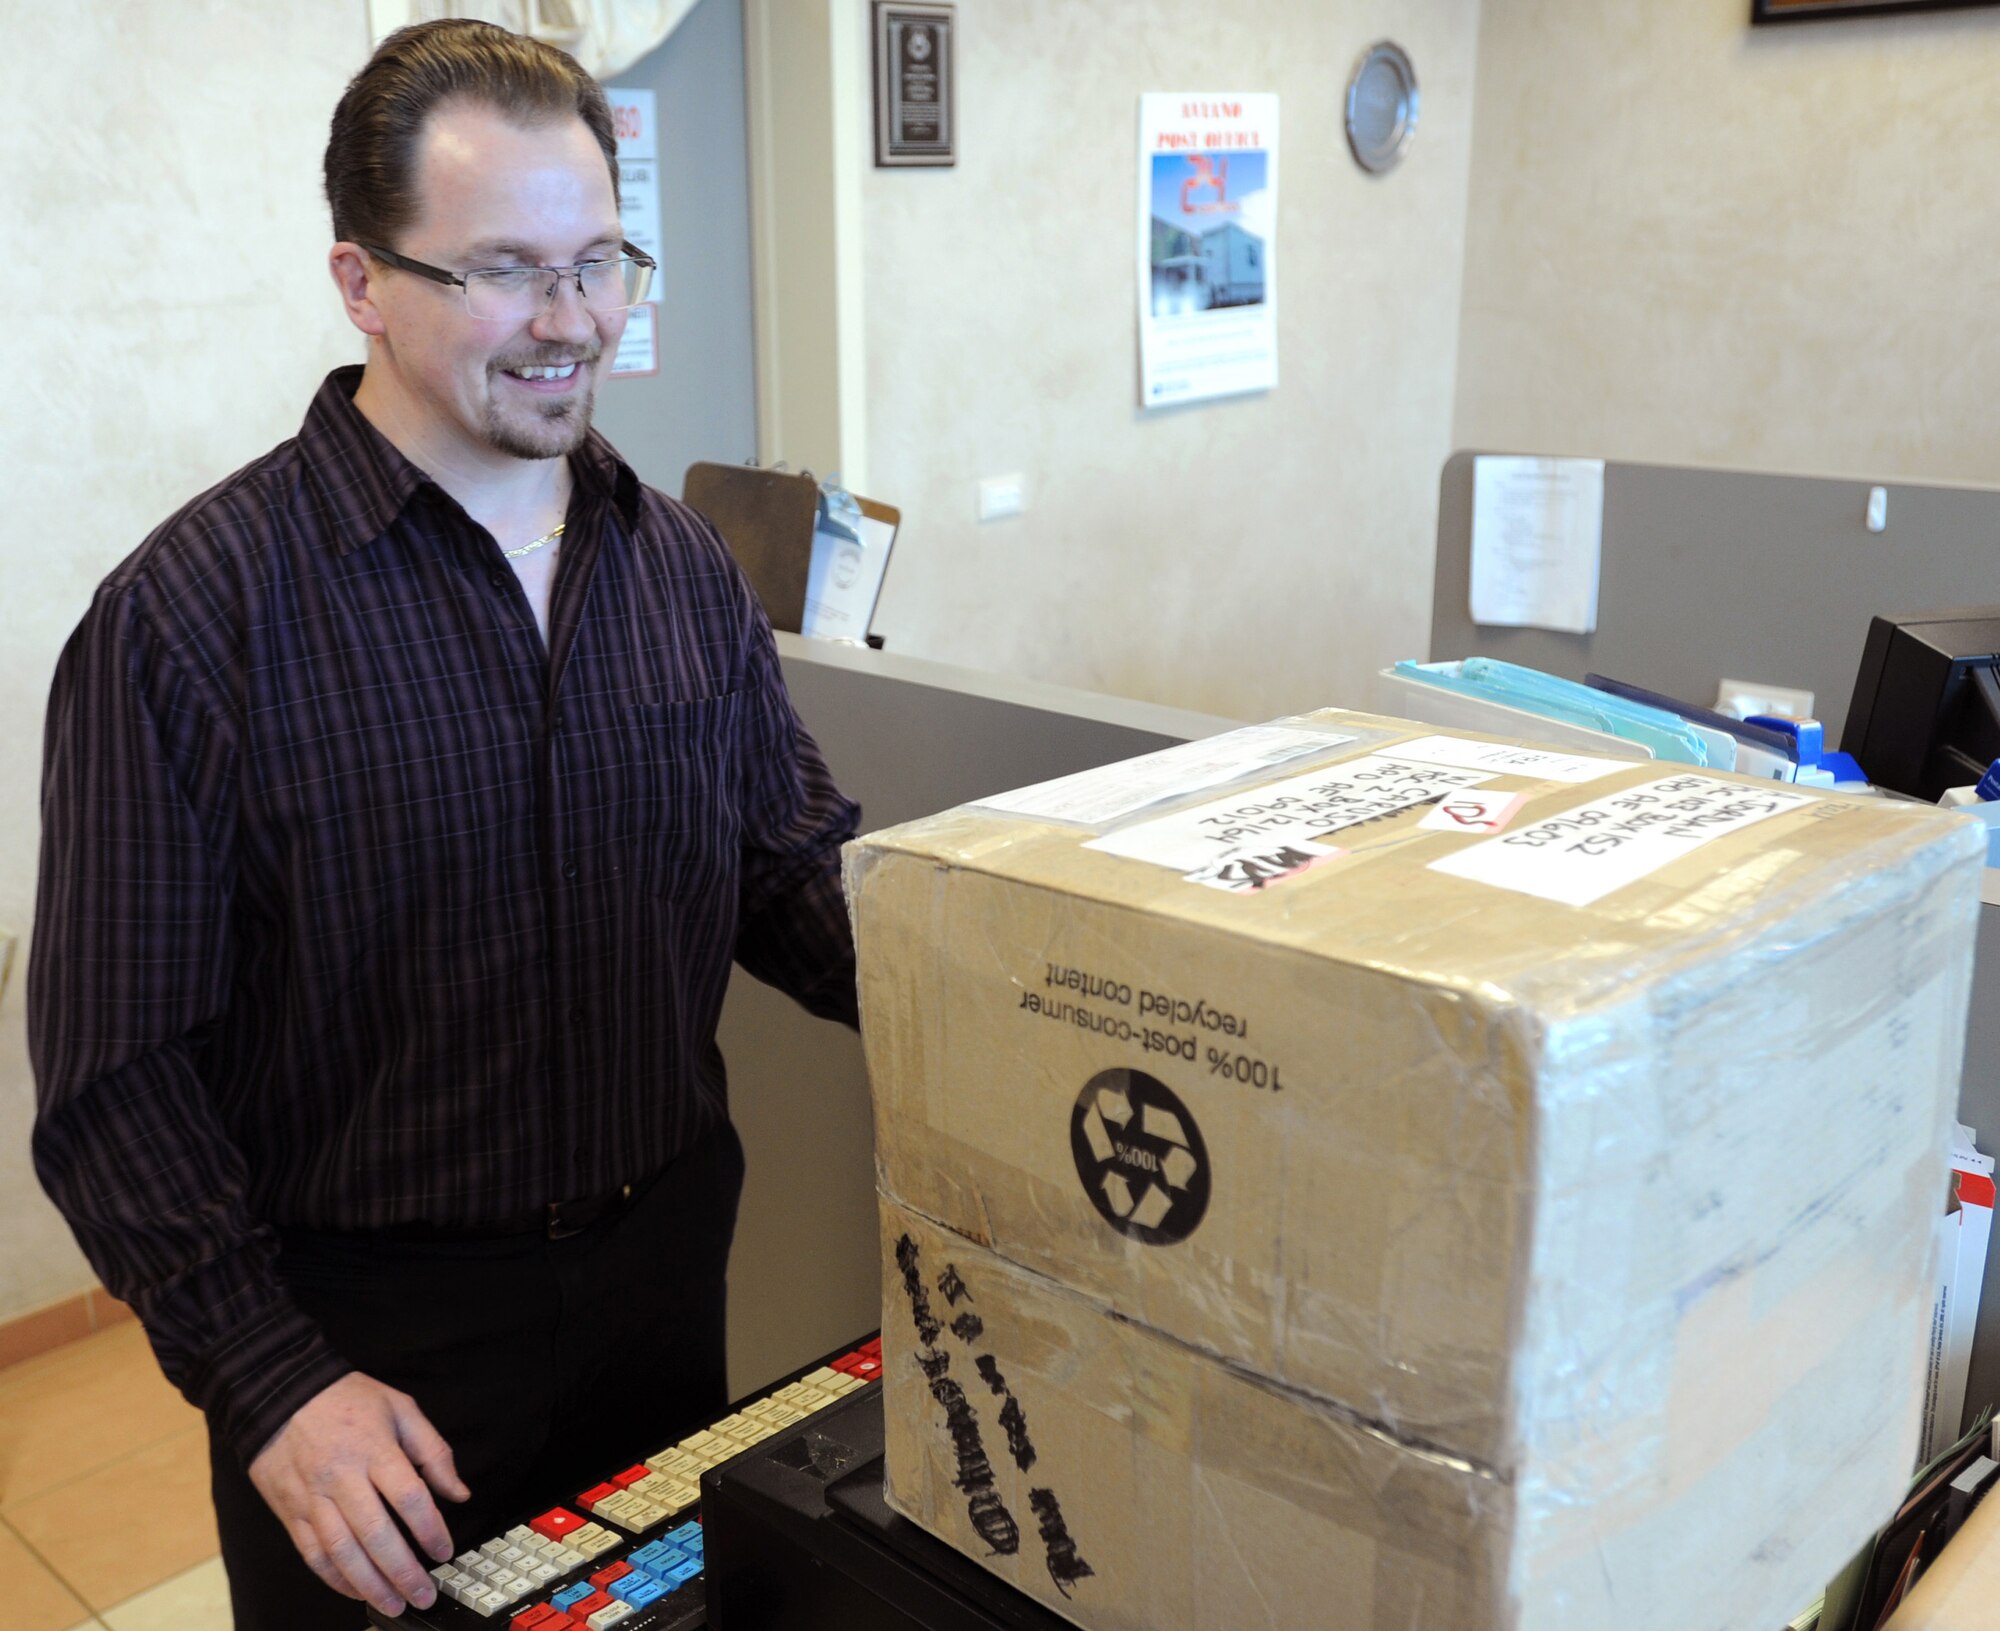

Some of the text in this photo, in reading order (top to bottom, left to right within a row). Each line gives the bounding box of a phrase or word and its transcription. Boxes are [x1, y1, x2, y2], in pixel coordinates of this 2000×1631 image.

[1198, 763, 1412, 825] APO AE 09012
[1296, 795, 1365, 813] BOX
[1363, 785, 1394, 793] 2
[1611, 794, 1660, 810] AE
[1663, 796, 1716, 811] 103
[1304, 788, 1431, 828] CARUSO
[1609, 811, 1678, 832] BOX
[1662, 800, 1777, 839] JORDAN
[1204, 813, 1302, 844] 12164
[1502, 810, 1612, 847] 09603
[1565, 832, 1634, 855] 152
[1045, 962, 1248, 1039] recycled content
[1020, 991, 1284, 1092] 100% post-consumer
[1115, 1142, 1159, 1172] 100%
